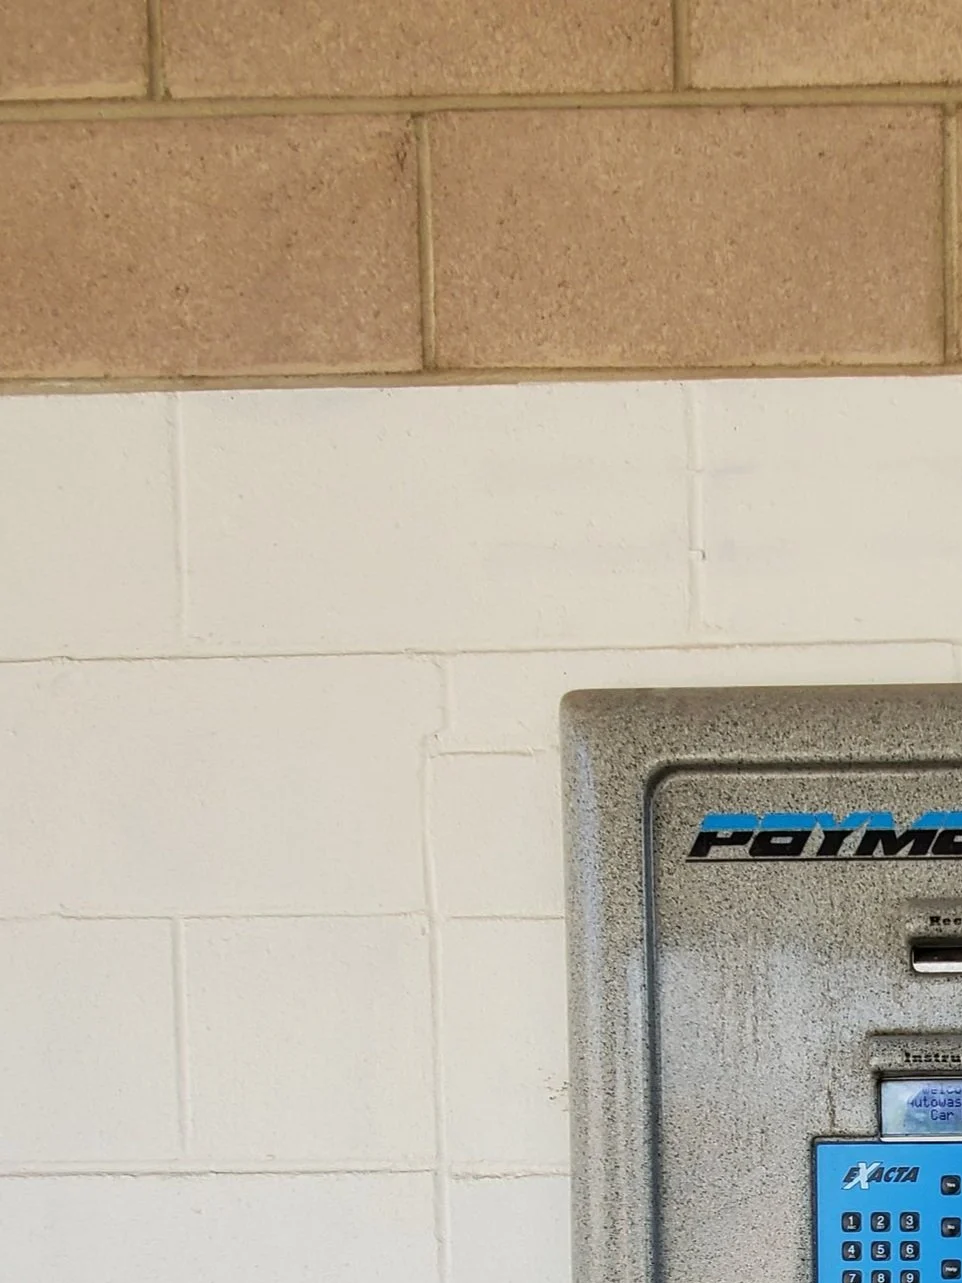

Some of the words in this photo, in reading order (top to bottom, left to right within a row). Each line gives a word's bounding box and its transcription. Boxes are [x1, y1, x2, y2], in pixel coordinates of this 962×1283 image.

[930, 1109, 954, 1121] Car
[848, 1215, 854, 1225] 1
[877, 1215, 884, 1225] 2
[906, 1215, 914, 1225] 3
[847, 1244, 855, 1254] 4
[877, 1244, 885, 1254] 5
[906, 1244, 914, 1254] 6
[848, 1273, 856, 1283] 7
[877, 1273, 885, 1283] 8
[906, 1273, 914, 1283] 9
